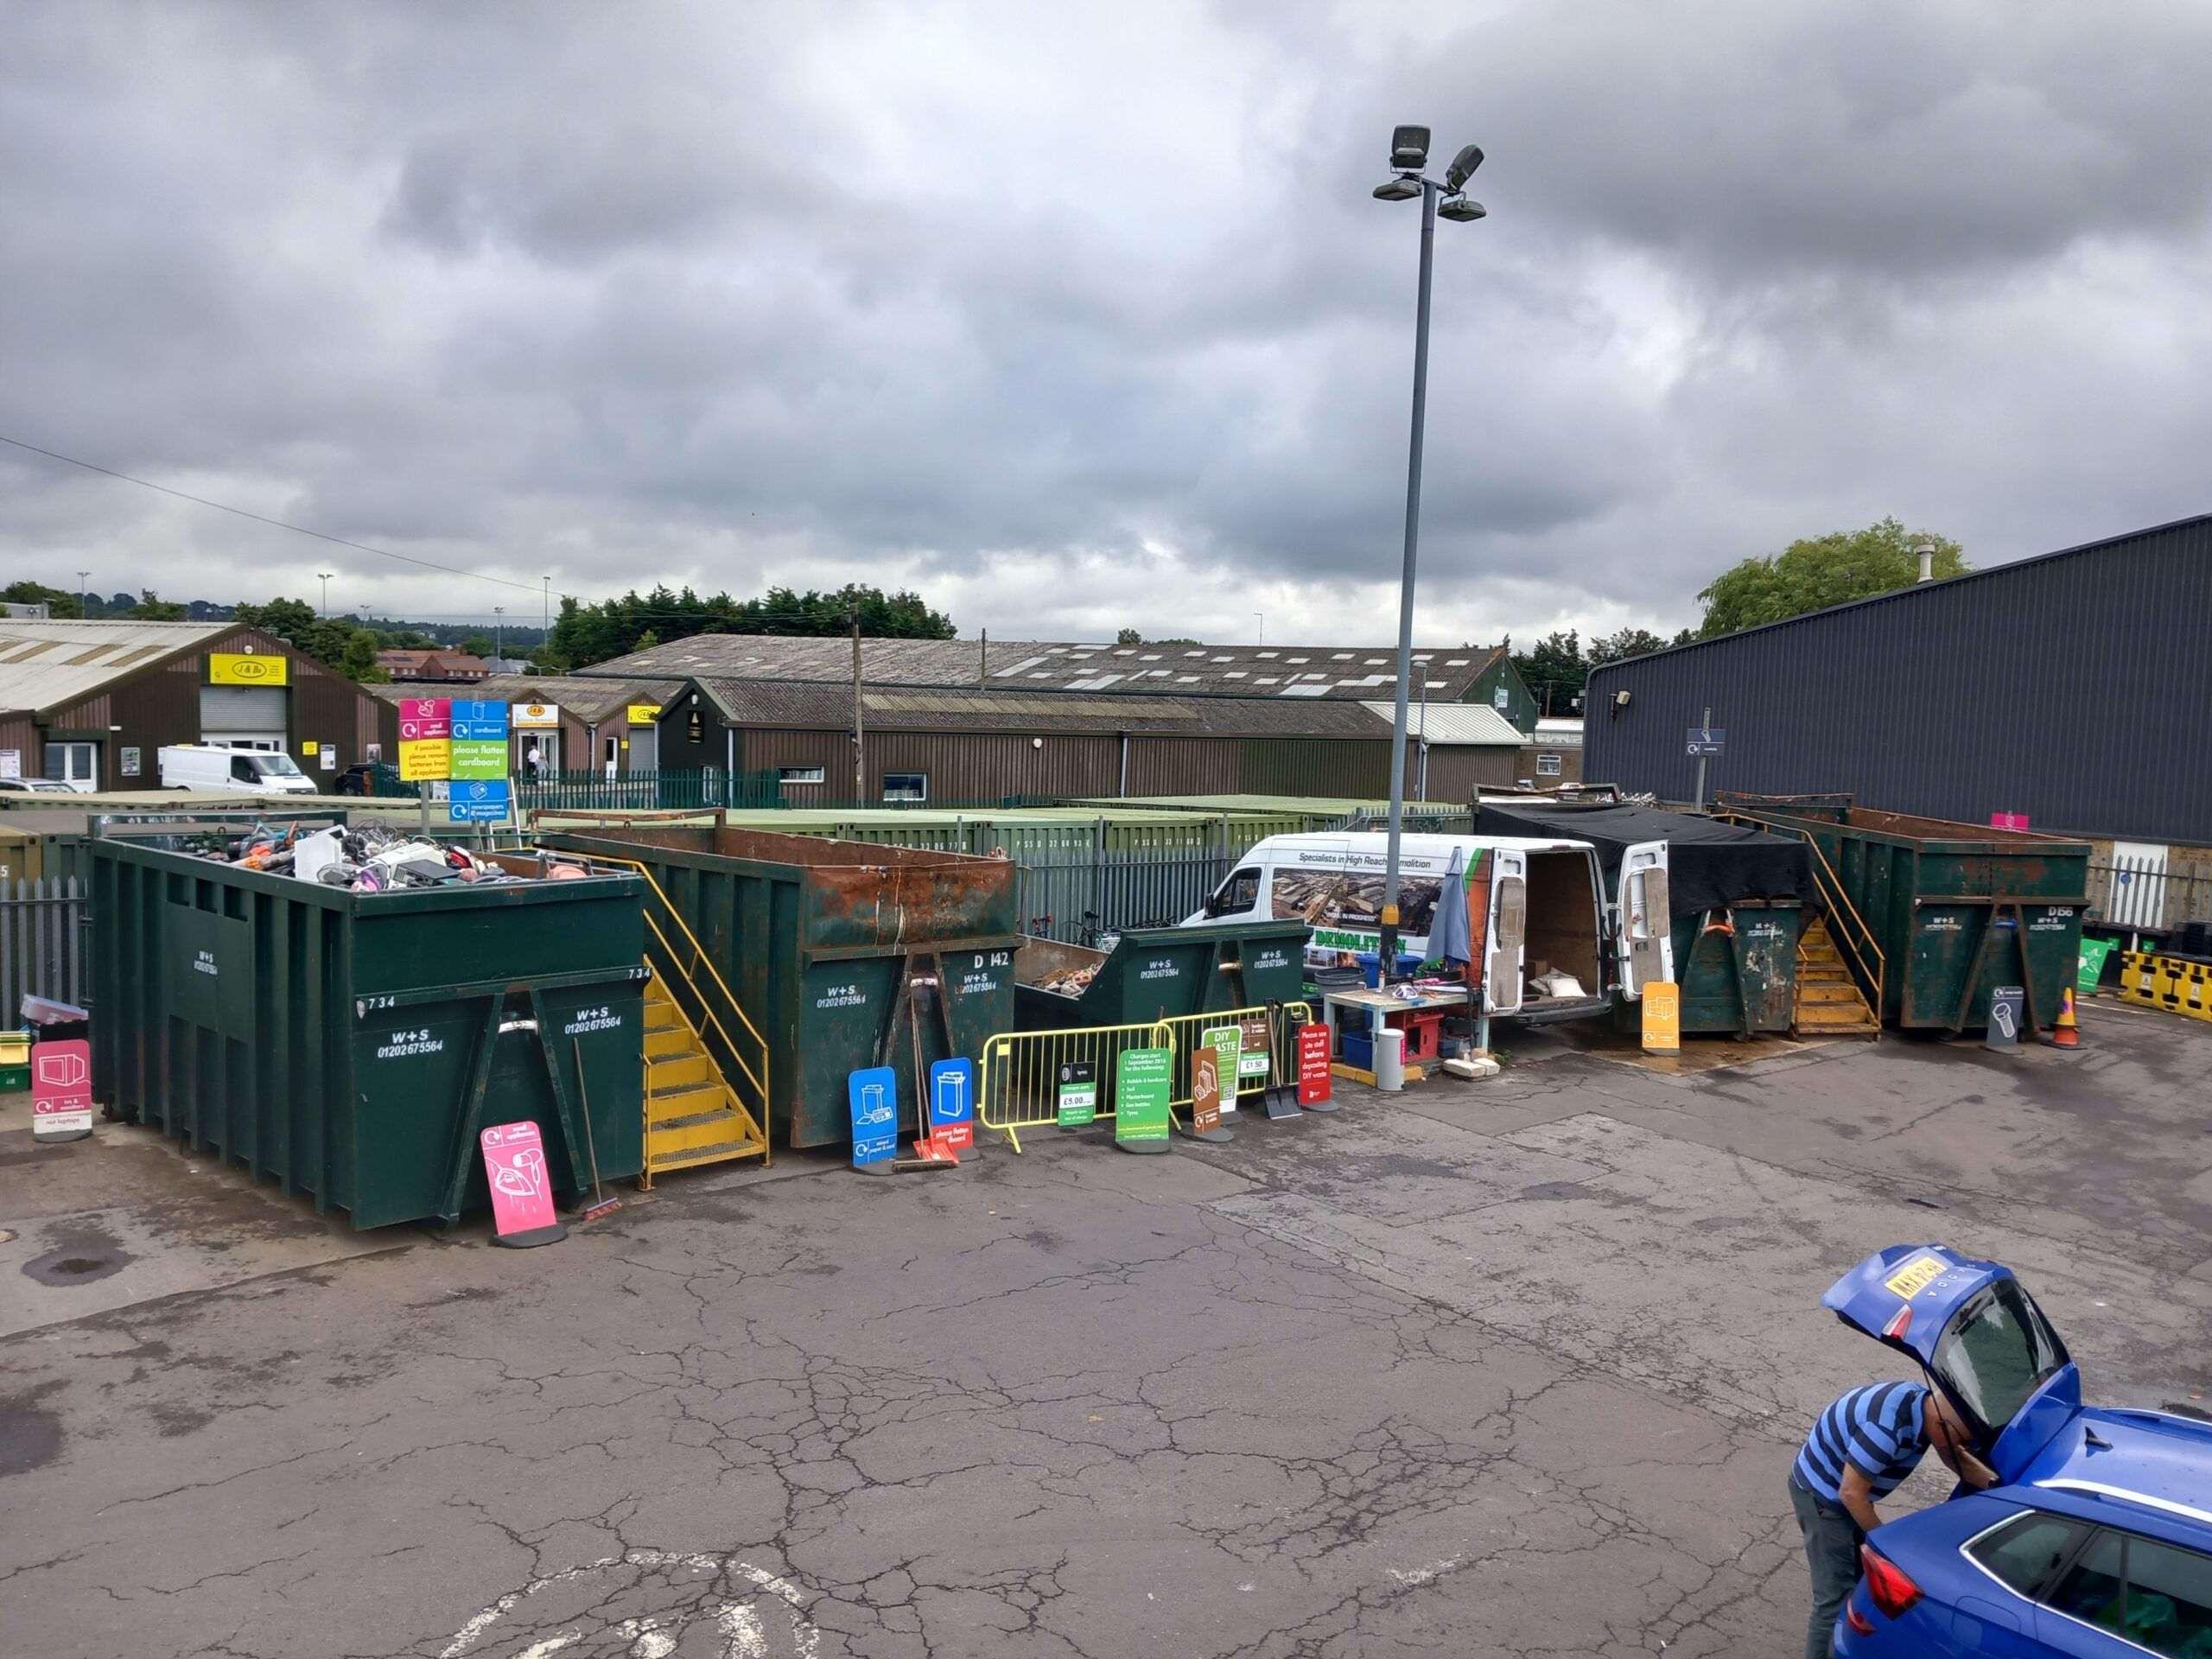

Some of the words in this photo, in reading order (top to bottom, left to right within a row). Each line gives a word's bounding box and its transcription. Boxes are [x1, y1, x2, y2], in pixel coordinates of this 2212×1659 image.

[453, 745, 479, 756] please
[480, 745, 505, 754] flatten
[458, 757, 501, 766] cardboard
[1299, 852, 1337, 864] Specialists
[1346, 855, 1363, 866] High
[1364, 855, 1388, 866] Reach
[1398, 859, 1431, 869] molition
[2048, 906, 2056, 916] D
[1315, 930, 1407, 954] DEMOLITN
[974, 955, 983, 969] D
[990, 951, 1009, 966] 142
[1261, 950, 1282, 960] W+S
[1149, 959, 1172, 969] W+S
[828, 985, 855, 997] W+S
[576, 1006, 608, 1021] W+S
[391, 1028, 429, 1044] W+S
[1214, 1032, 1230, 1042] DIY
[1206, 1042, 1237, 1052] ASTE
[1313, 1039, 1325, 1048] staff
[1305, 1051, 1325, 1059] before
[1301, 1061, 1327, 1071] depositing
[1303, 1071, 1313, 1080] DIY
[1064, 1096, 1084, 1106] £5.00
[936, 1130, 952, 1139] please
